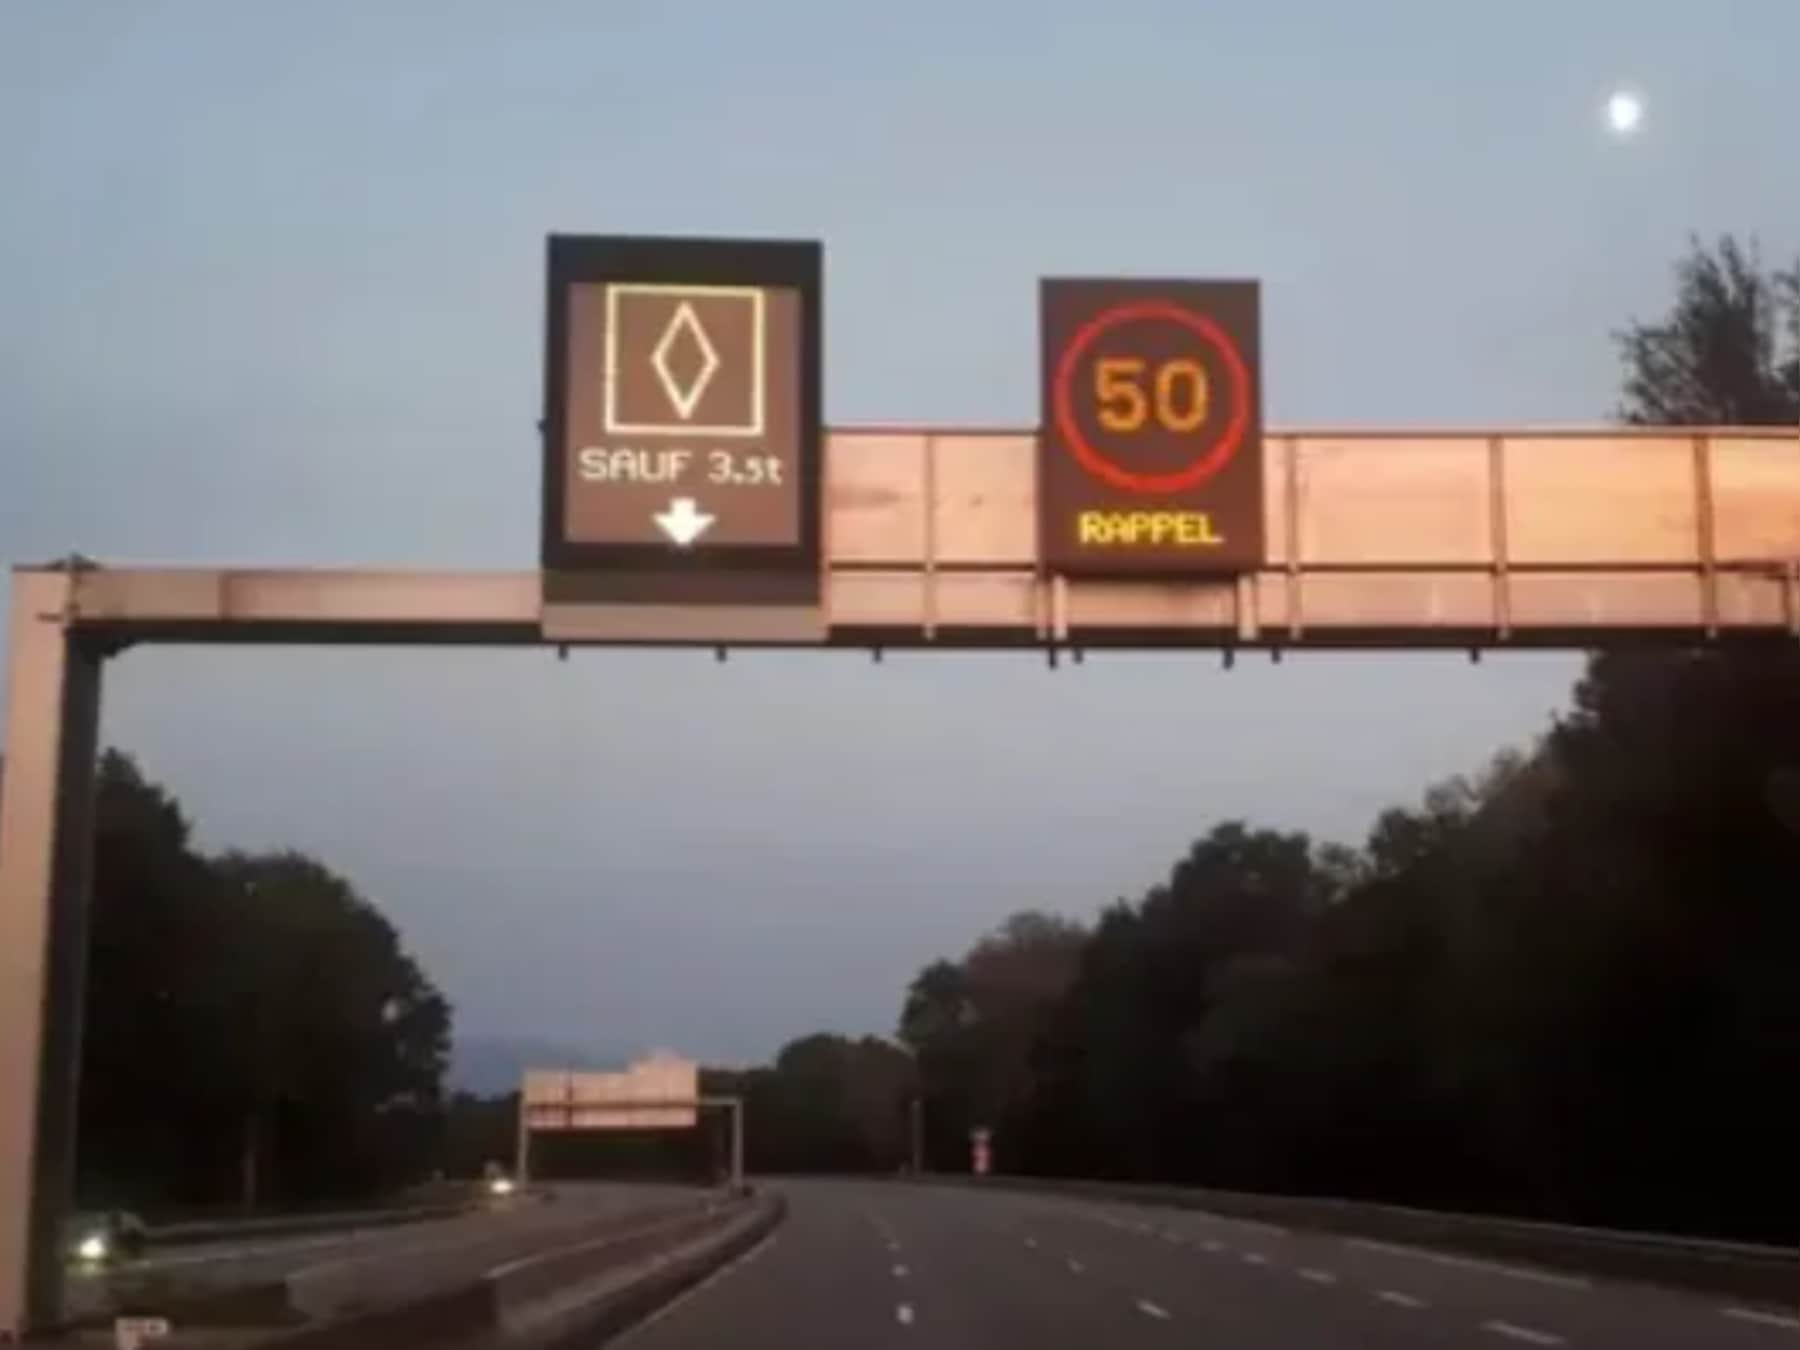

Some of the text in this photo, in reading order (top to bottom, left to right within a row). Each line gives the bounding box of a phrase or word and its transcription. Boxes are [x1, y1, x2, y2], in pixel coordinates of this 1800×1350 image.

[1095, 358, 1209, 432] 50
[579, 448, 692, 482] SAUF
[1079, 512, 1223, 544] RAPPEL
